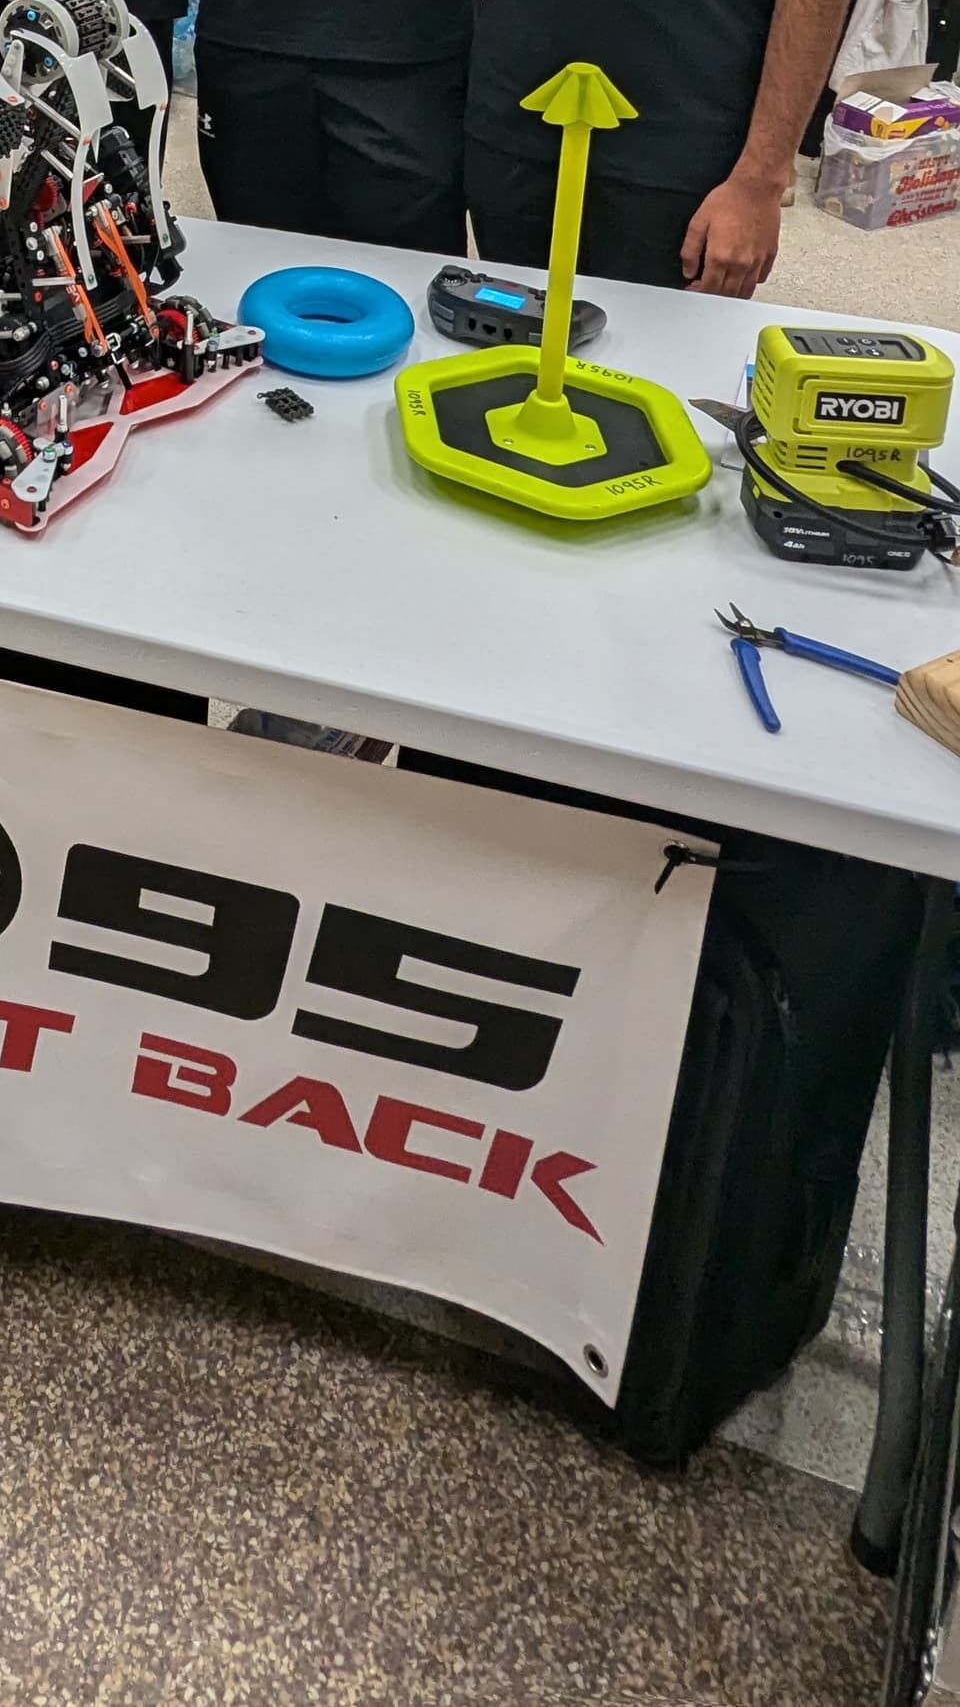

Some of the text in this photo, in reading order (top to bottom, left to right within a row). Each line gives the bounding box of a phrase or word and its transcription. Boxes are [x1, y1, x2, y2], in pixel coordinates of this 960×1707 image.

[576, 360, 633, 384] 1095R
[407, 389, 426, 416] 1095R
[820, 397, 900, 421] RYOBI
[846, 446, 903, 463] 1095R
[604, 474, 665, 496] 1095R
[842, 553, 877, 566] 1095
[131, 1032, 604, 1246] BACK
